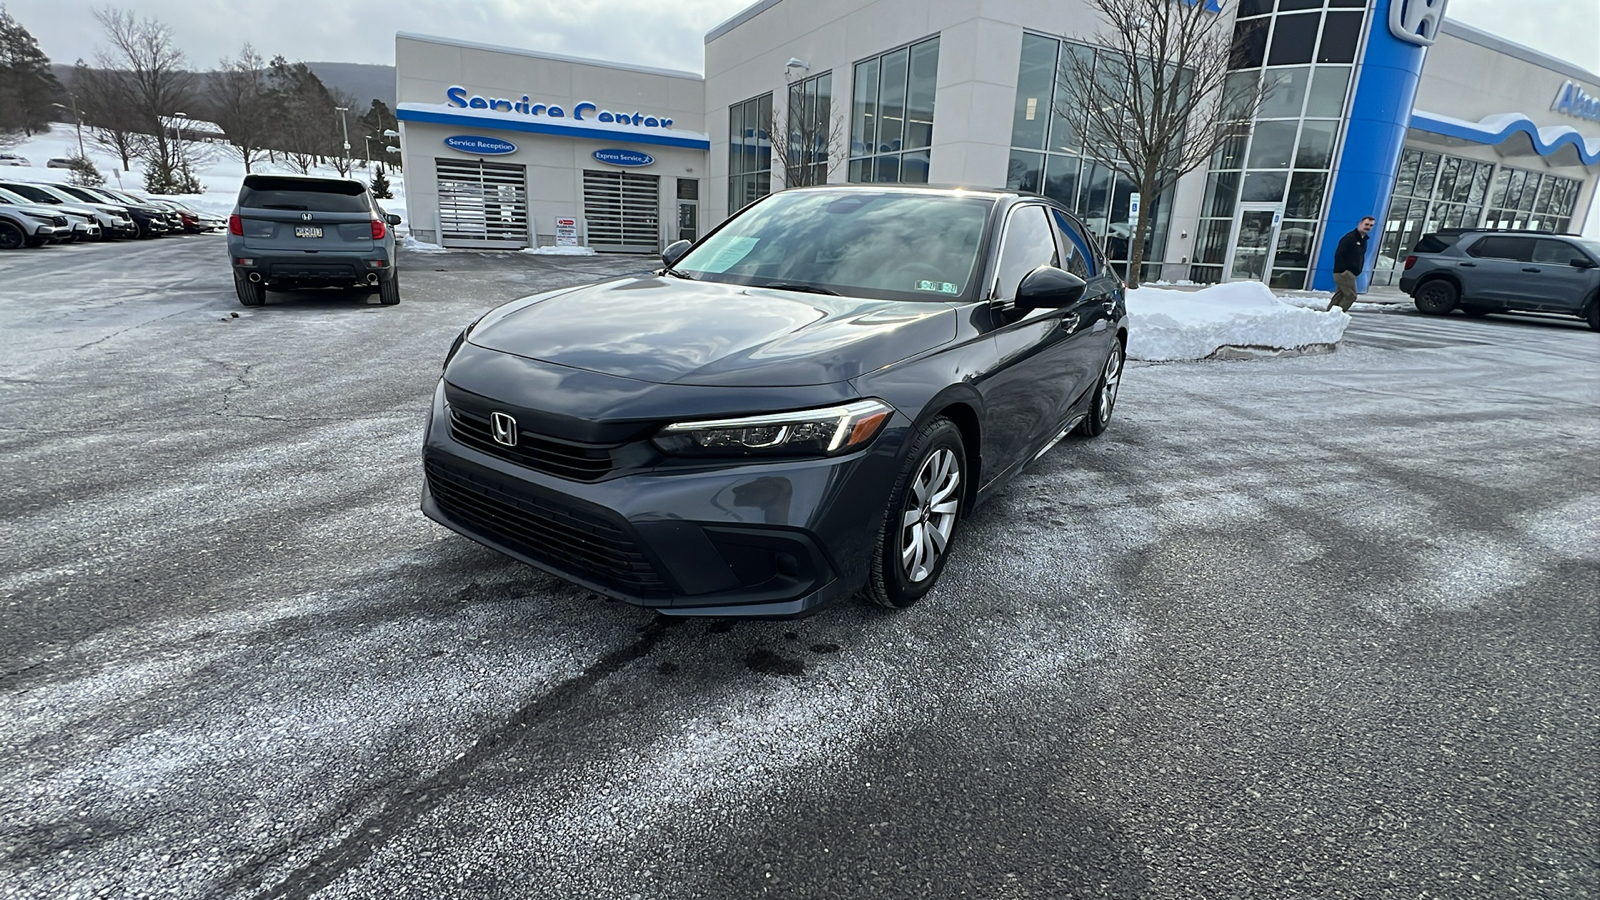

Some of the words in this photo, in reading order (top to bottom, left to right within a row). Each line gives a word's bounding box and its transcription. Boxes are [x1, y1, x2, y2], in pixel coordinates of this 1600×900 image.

[447, 86, 565, 117] Service
[573, 102, 674, 129] Center
[448, 138, 476, 148] Service
[477, 140, 513, 151] Reception
[595, 151, 619, 160] Express
[619, 154, 642, 162] Service
